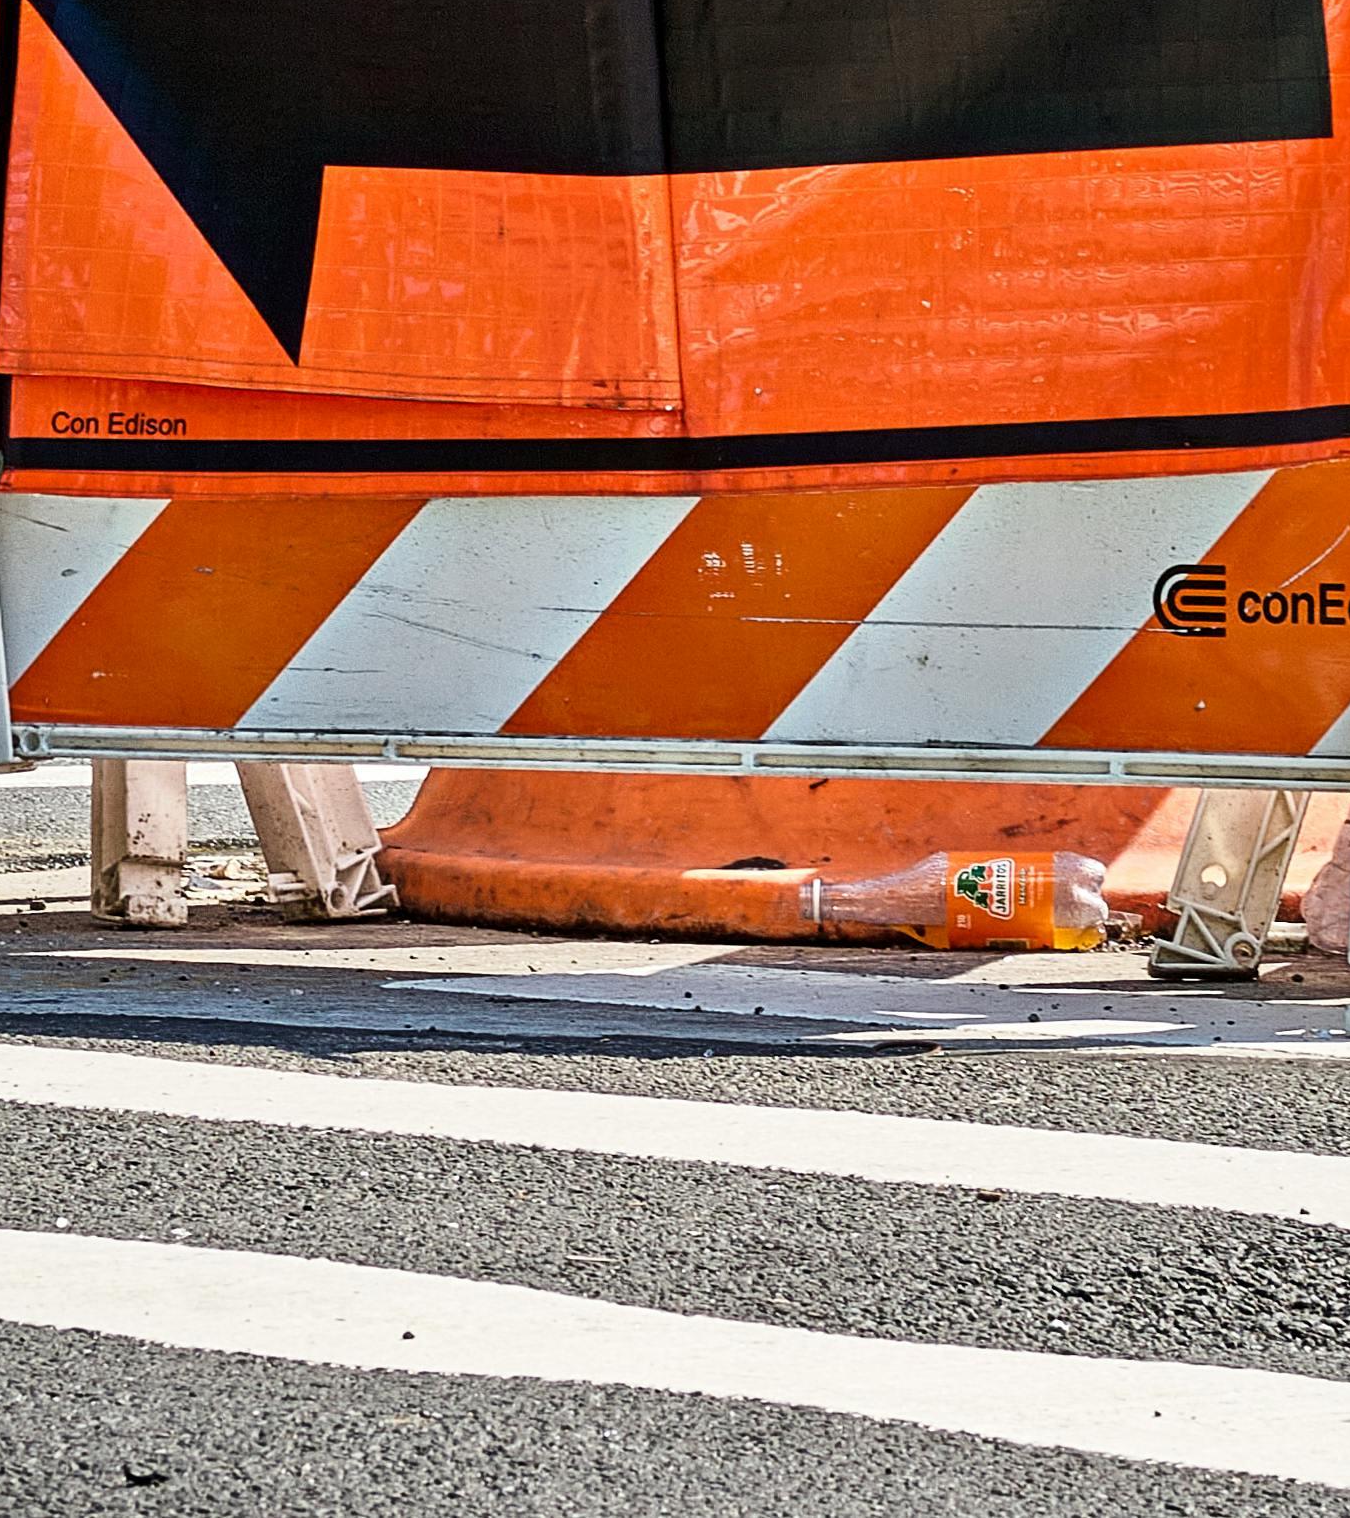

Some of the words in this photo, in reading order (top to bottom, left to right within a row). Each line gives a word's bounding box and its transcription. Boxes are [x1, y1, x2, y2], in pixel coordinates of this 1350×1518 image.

[51, 411, 99, 434] Con
[108, 412, 187, 436] Edison
[995, 862, 1007, 913] JARRITOS
